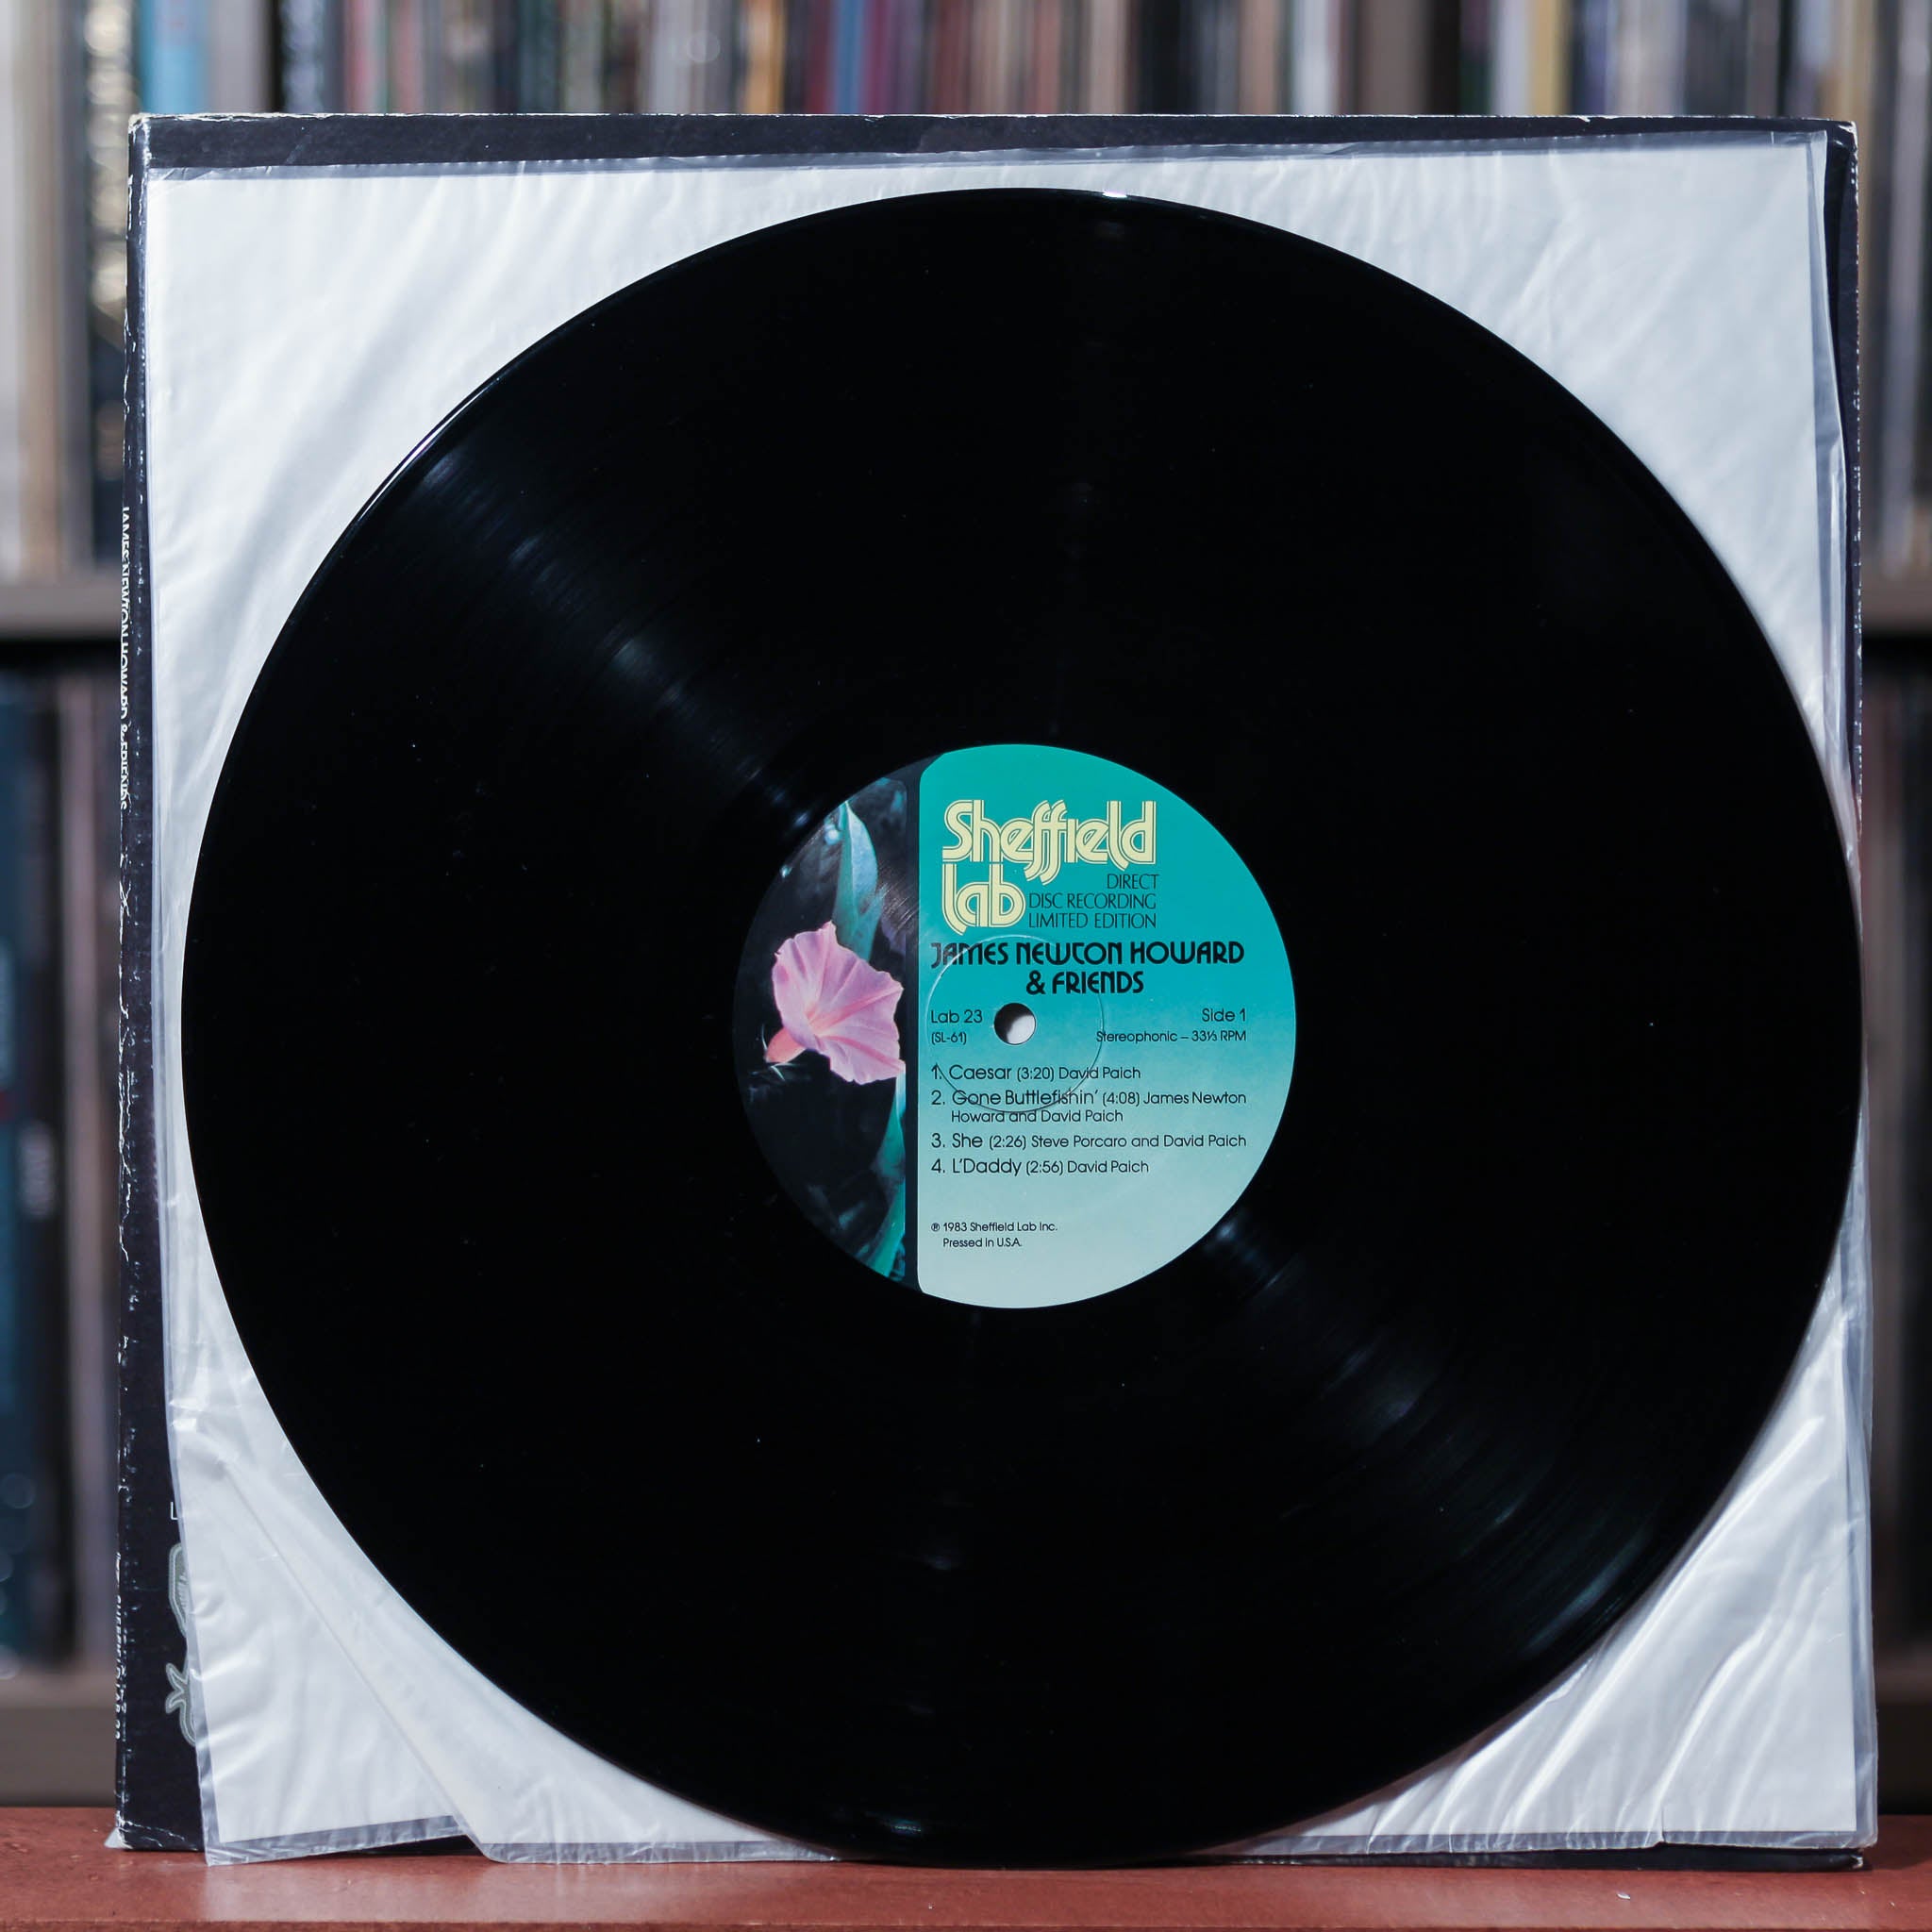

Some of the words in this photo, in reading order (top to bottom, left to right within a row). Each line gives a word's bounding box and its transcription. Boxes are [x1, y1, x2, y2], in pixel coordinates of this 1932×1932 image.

[941, 800, 1157, 885] Sheffield
[1107, 874, 1159, 890] DIRECT
[1028, 893, 1062, 908] DISC
[1067, 893, 1157, 909] RECORDING
[1028, 913, 1089, 928] LIMITED
[1094, 913, 1157, 928] EDITION
[931, 942, 1008, 968] JAMES
[1016, 942, 1123, 965] NEWTON
[1130, 941, 1245, 965] HOWARD
[1025, 971, 1045, 994] &
[1052, 971, 1144, 994] FRIENDS
[930, 1009, 960, 1024] Lab
[964, 1009, 983, 1024] 23
[1201, 1008, 1236, 1022] Side
[1240, 1008, 1246, 1022] 1
[931, 1032, 967, 1045] (SL-61)
[1096, 1031, 1177, 1045] Stereophonic
[1220, 1030, 1246, 1042] RPM
[931, 1065, 943, 1080] 1.
[949, 1065, 1012, 1080] Caesar
[1017, 1067, 1054, 1081] (3:20)
[1059, 1067, 1099, 1079] David
[1103, 1067, 1141, 1079] Paich
[930, 1090, 946, 1106] 2.
[952, 1091, 1002, 1106] Gone
[1103, 1091, 1141, 1106] (4:08)
[1143, 1091, 1189, 1105] James
[1192, 1091, 1247, 1105] Newton
[951, 1110, 1005, 1123] Howard
[1008, 1110, 1037, 1123] and
[1041, 1110, 1081, 1123] David
[1086, 1109, 1124, 1123] Paich
[930, 1133, 946, 1149] 3.
[952, 1133, 984, 1149] She
[989, 1135, 1026, 1150] (2:26)
[1031, 1135, 1070, 1148] Steve
[1074, 1135, 1127, 1148] Porcaro
[1131, 1135, 1159, 1148] and
[1164, 1135, 1205, 1148] David
[1208, 1135, 1247, 1148] Paich
[930, 1158, 946, 1174] 4.
[1025, 1160, 1064, 1175] (2:56)
[1068, 1160, 1108, 1174] David
[1111, 1160, 1149, 1174] Paich
[943, 1222, 968, 1232] 1983
[970, 1222, 1015, 1232] Sheffield
[1017, 1222, 1038, 1232] Lab
[1040, 1222, 1058, 1232] Inc.
[943, 1238, 983, 1248] Pressed
